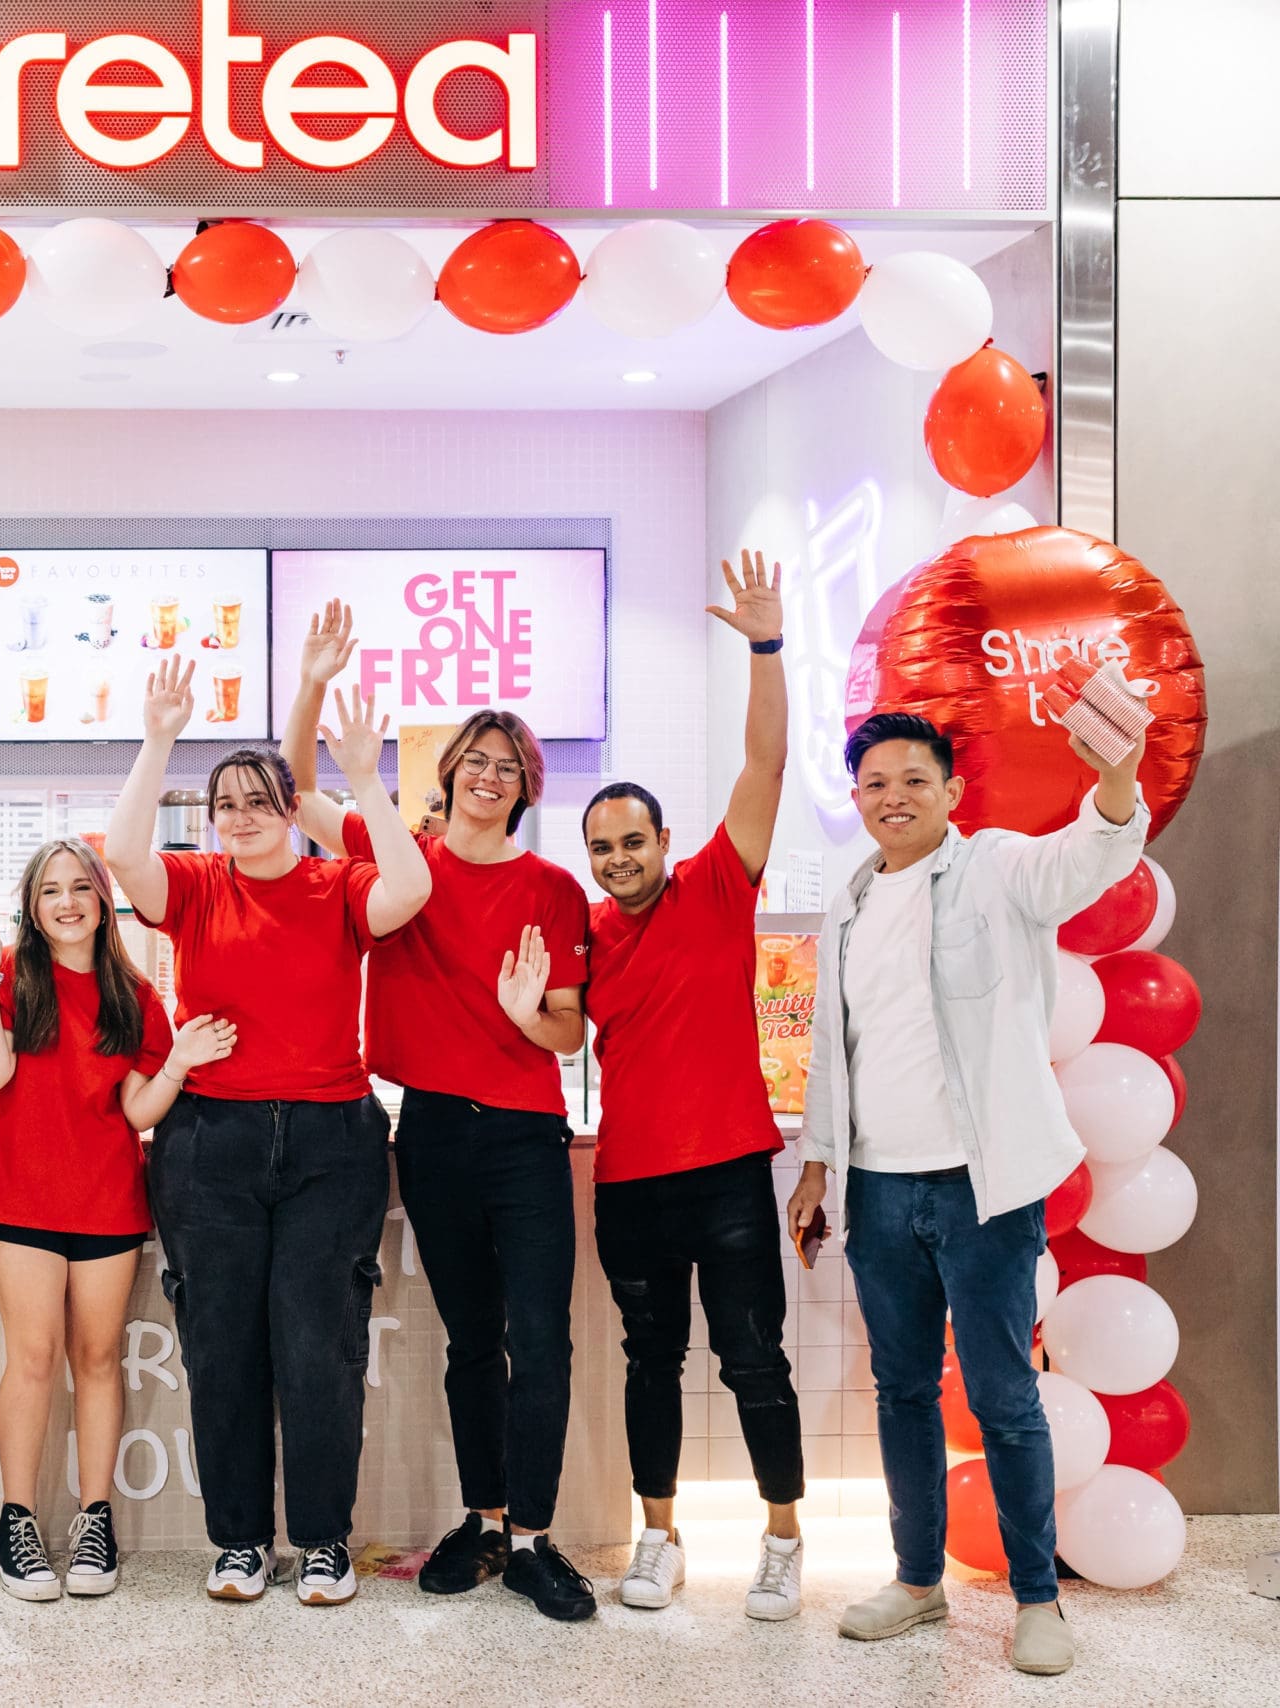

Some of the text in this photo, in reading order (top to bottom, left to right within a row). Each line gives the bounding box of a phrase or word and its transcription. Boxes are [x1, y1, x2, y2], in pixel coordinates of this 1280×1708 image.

[31, 563, 208, 579] FAVOURITES
[404, 570, 517, 619] GET
[419, 606, 532, 660] ONE
[360, 648, 532, 706] FREE
[754, 993, 815, 1020] ruity
[762, 1016, 810, 1040] Tea
